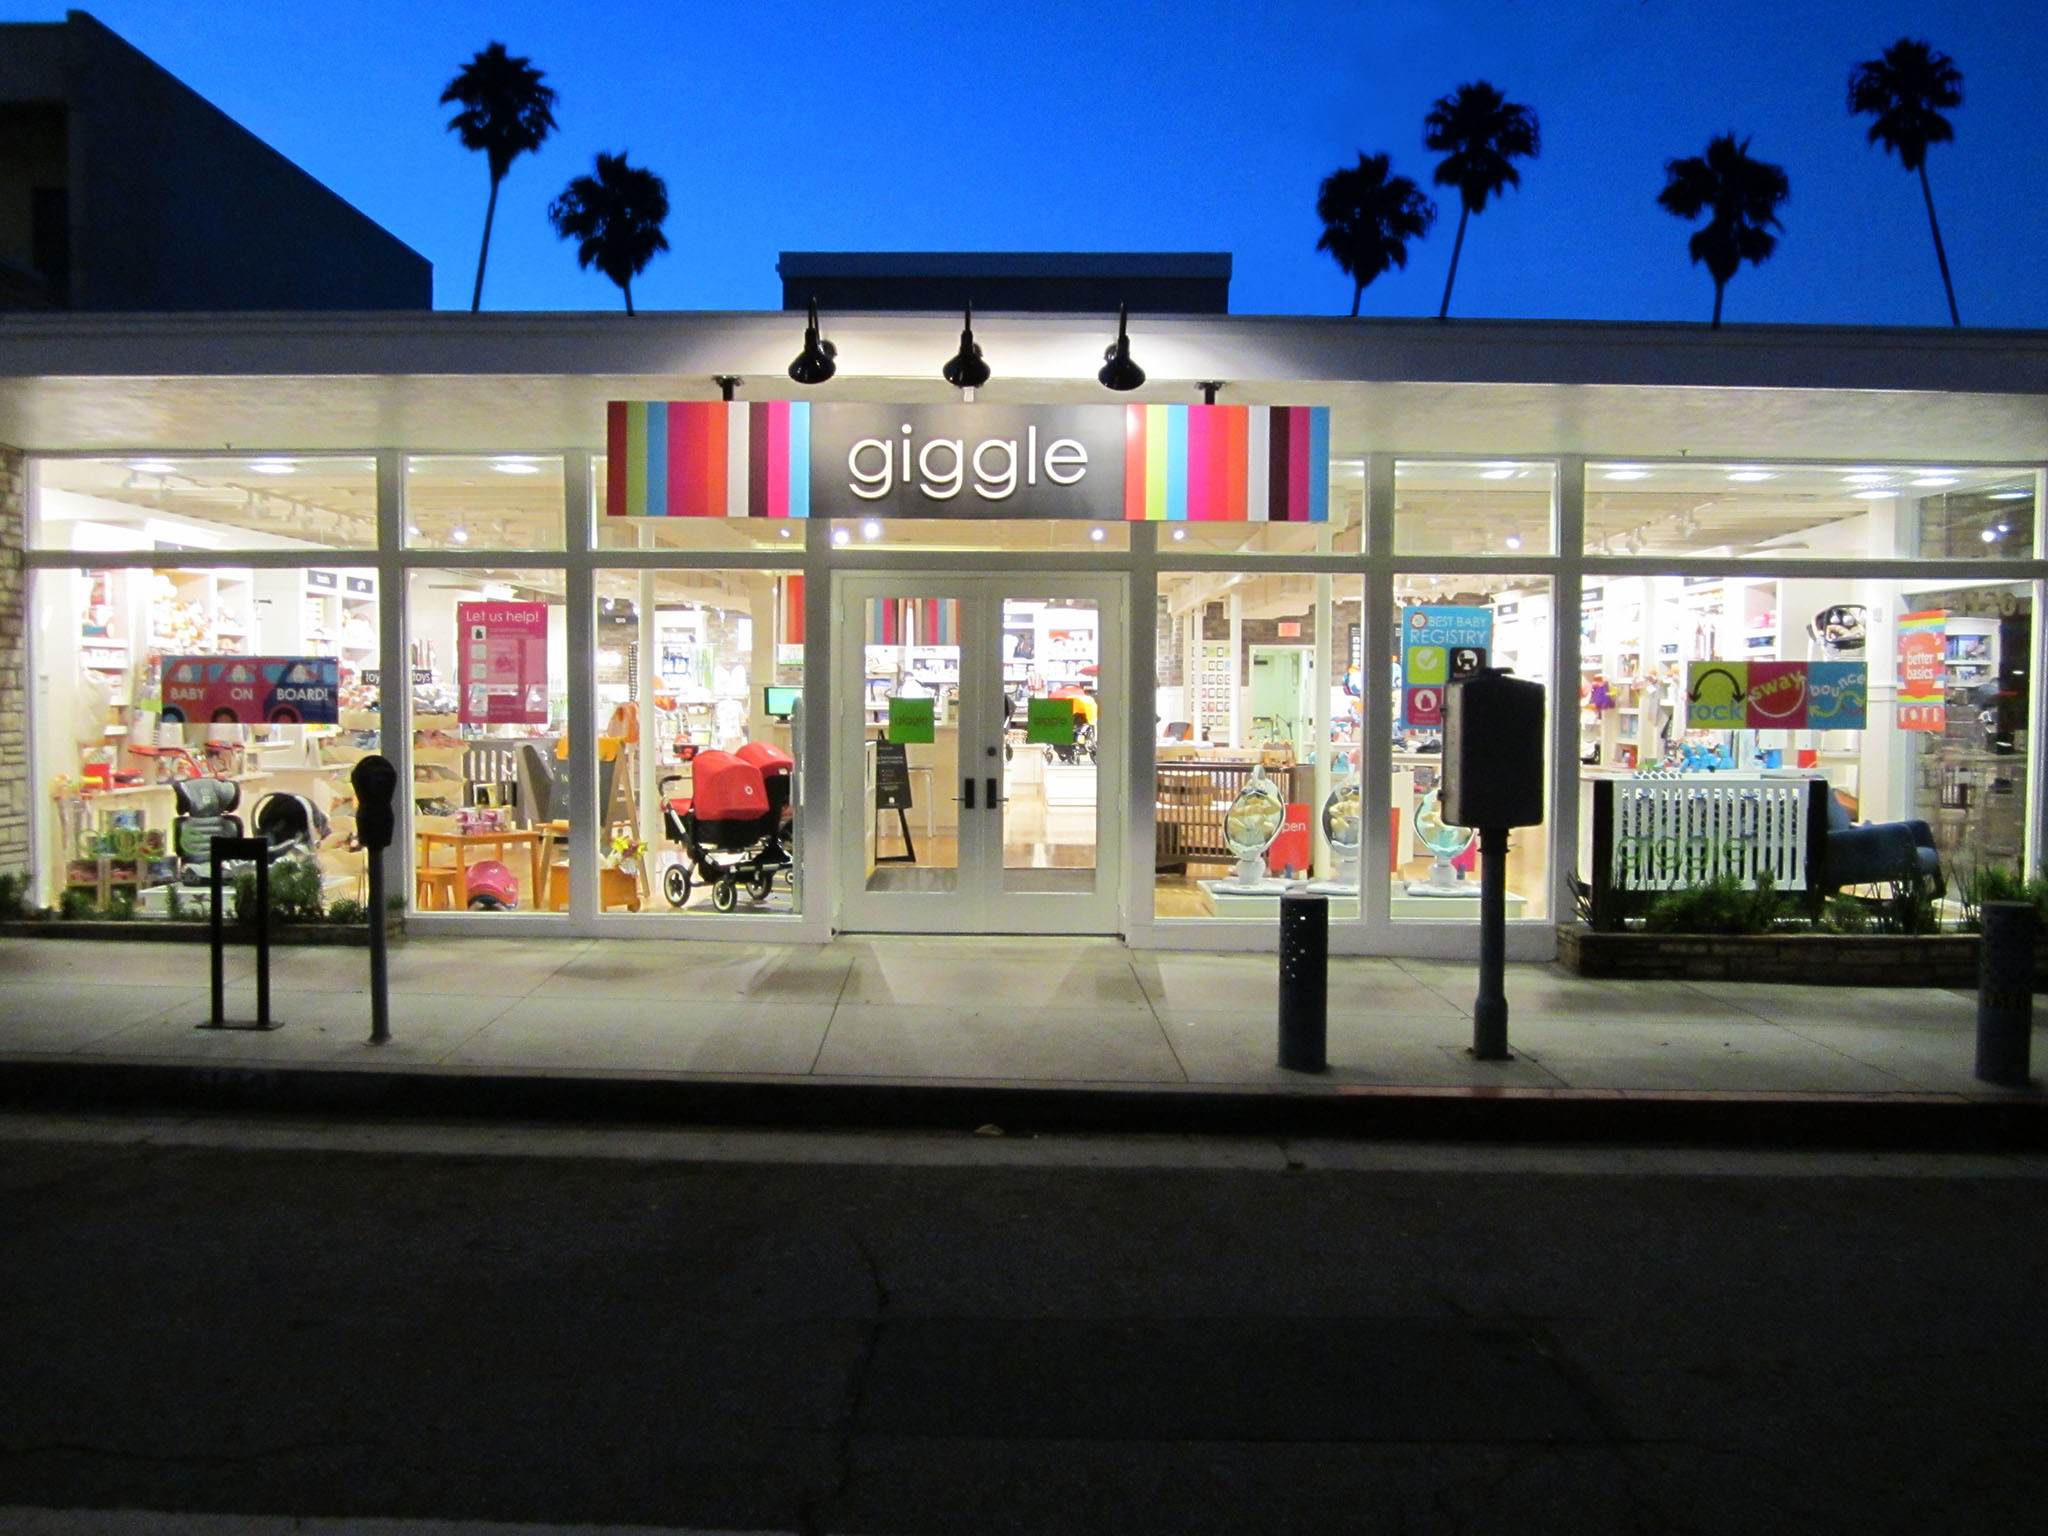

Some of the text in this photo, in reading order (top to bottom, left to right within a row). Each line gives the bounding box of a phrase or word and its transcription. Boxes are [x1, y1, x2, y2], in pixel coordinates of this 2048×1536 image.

[848, 423, 1089, 500] giggle
[466, 610, 540, 625] Let us help!
[1427, 615, 1488, 628] BEST BABY
[1410, 628, 1488, 645] REGISTRY
[1907, 649, 1934, 665] better
[1907, 666, 1934, 681] basics
[170, 687, 329, 701] BABY ON BOARD!
[1688, 670, 1867, 721] rock sway bounce
